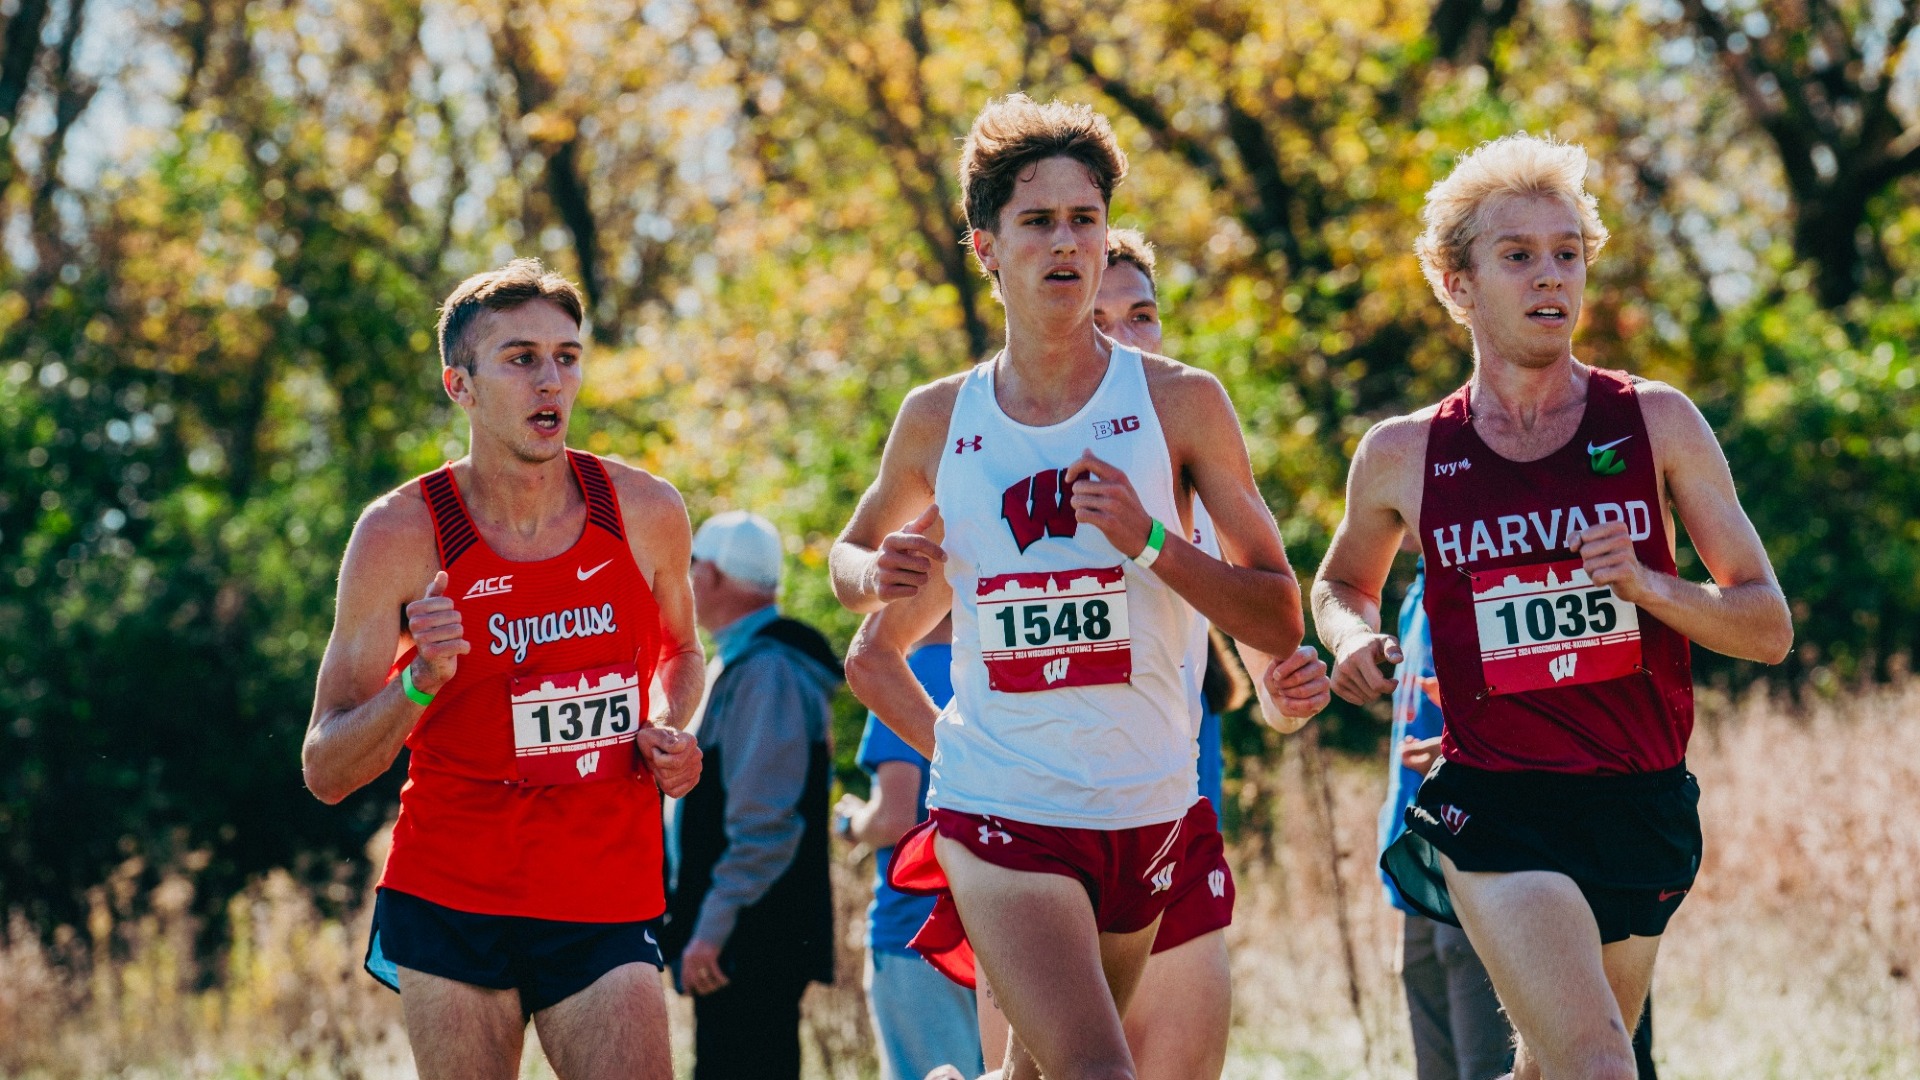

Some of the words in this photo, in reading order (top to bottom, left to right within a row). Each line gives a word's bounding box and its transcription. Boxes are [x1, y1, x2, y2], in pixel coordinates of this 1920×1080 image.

[1434, 461, 1457, 477] Ivy
[465, 575, 514, 597] ACC
[488, 602, 617, 664] Syracuse
[995, 599, 1111, 648] 1548
[1496, 589, 1617, 645] 1035
[531, 694, 631, 743] 1375
